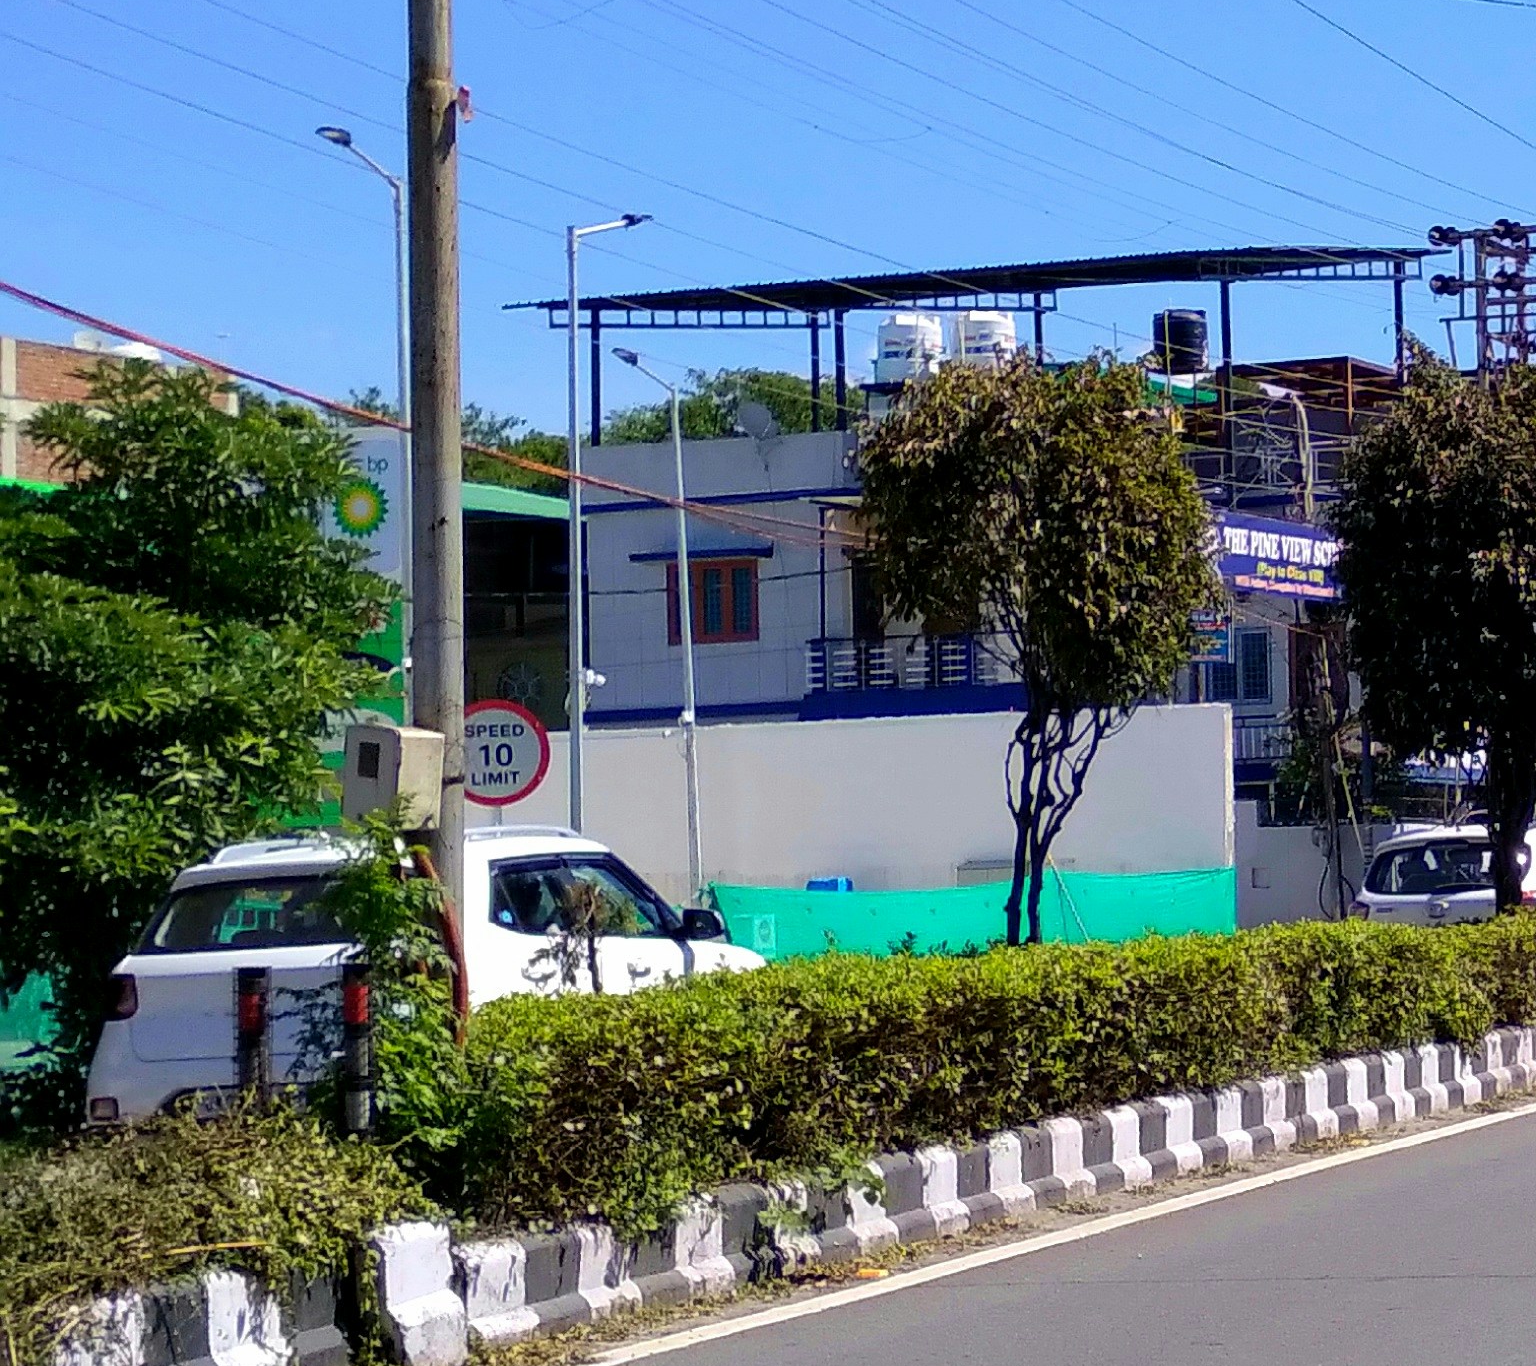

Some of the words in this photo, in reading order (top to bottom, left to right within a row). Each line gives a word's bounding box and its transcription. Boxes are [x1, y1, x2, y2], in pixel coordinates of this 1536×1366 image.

[1223, 526, 1249, 554] THE
[1250, 531, 1280, 560] PINE
[1281, 535, 1313, 565] VIEW
[464, 724, 524, 738] SPEED
[479, 743, 513, 767] 10
[471, 771, 520, 786] LIMIT
